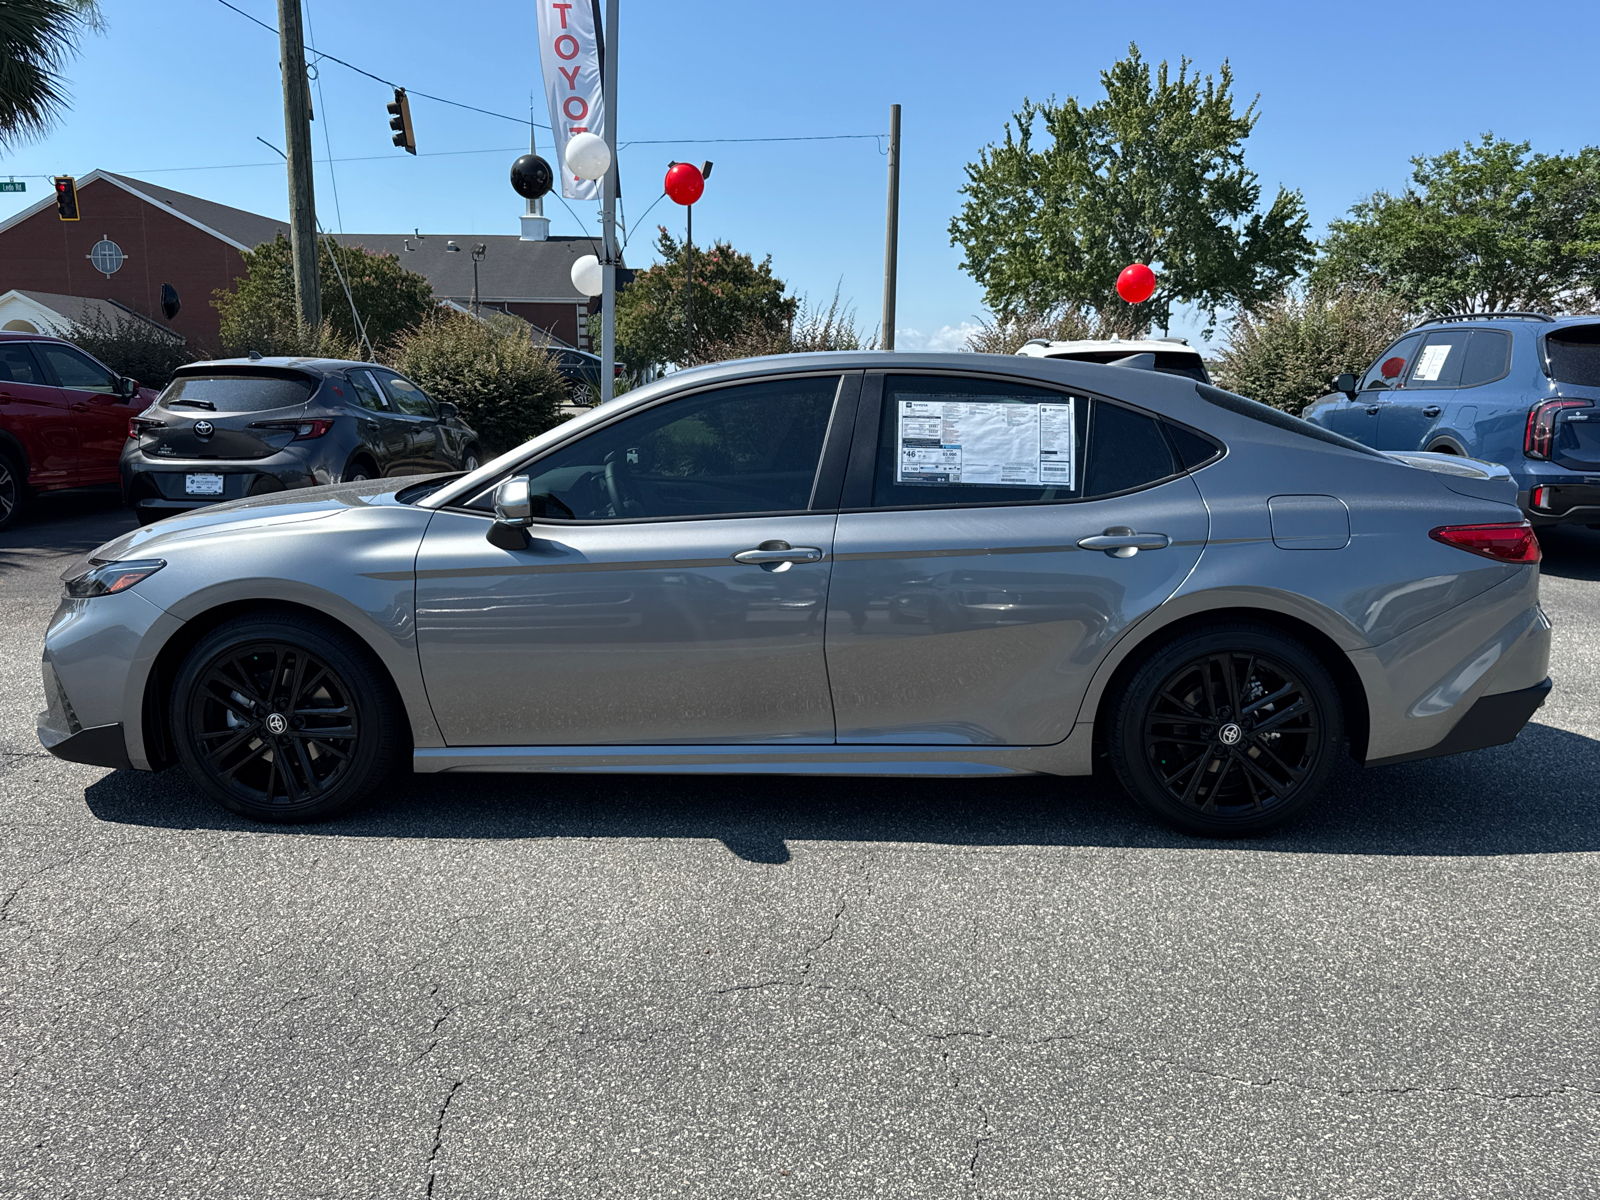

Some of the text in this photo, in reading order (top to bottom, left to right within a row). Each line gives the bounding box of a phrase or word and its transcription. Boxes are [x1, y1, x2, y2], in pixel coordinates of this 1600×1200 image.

[552, 3, 589, 181] TOYO
[15, 183, 22, 191] Rd
[906, 450, 916, 458] 46
